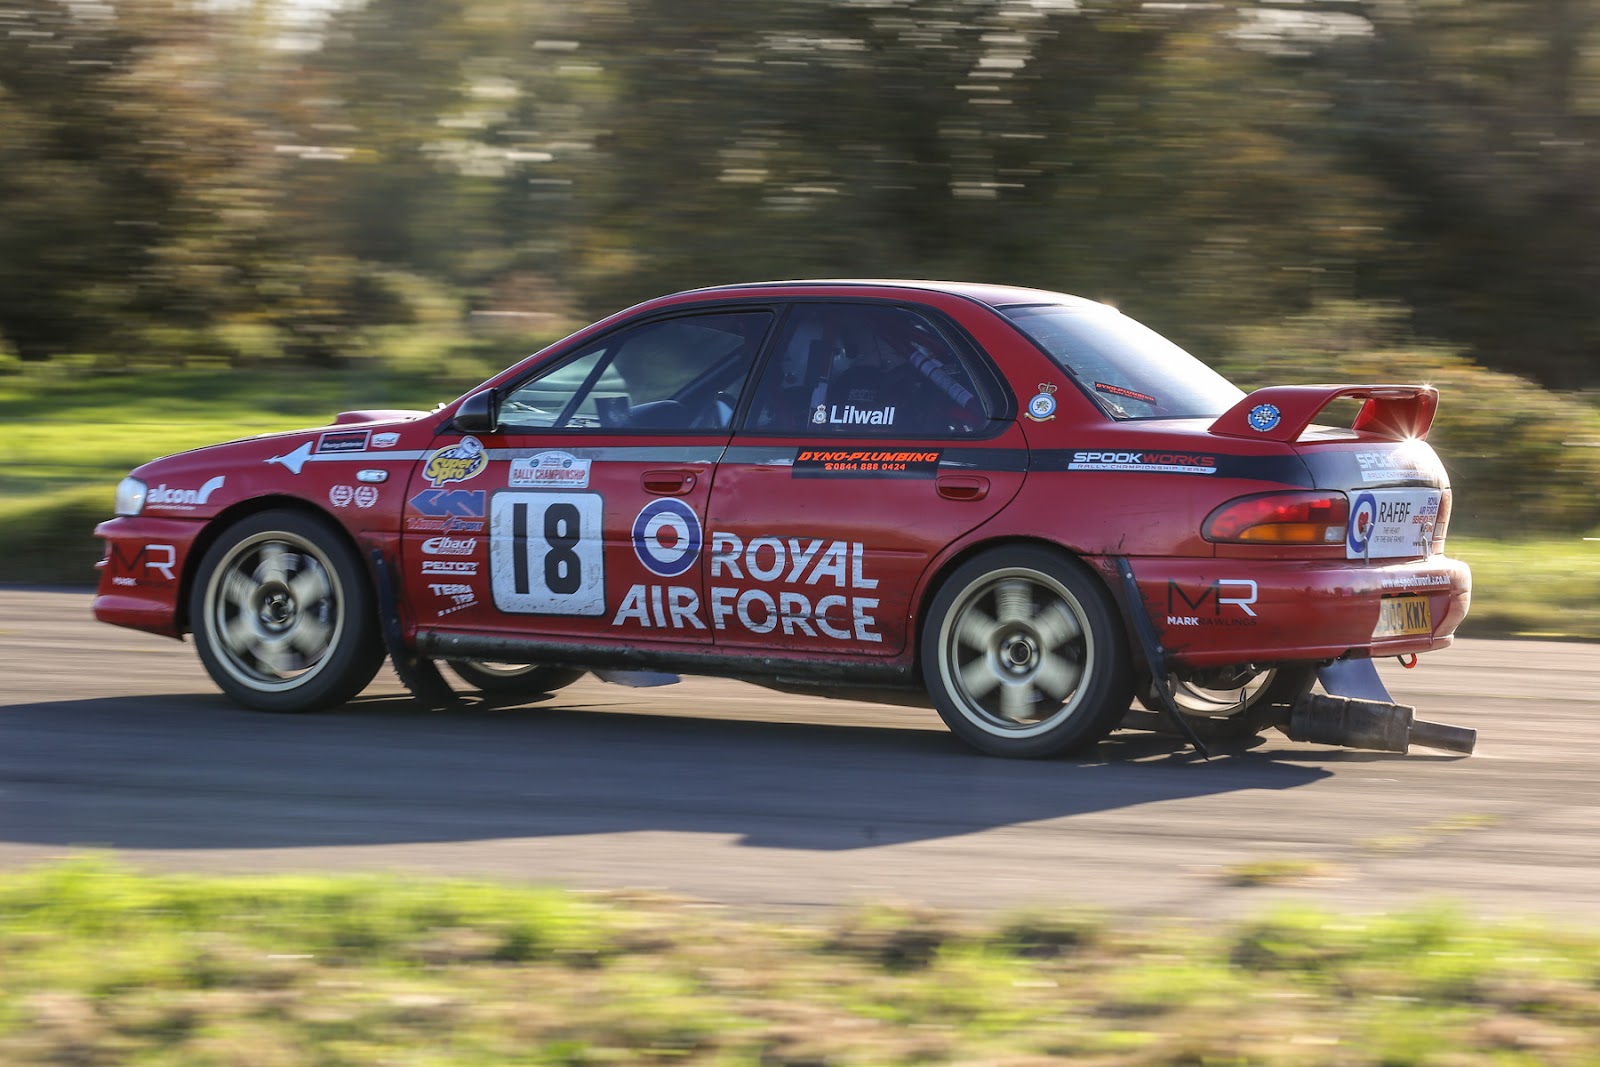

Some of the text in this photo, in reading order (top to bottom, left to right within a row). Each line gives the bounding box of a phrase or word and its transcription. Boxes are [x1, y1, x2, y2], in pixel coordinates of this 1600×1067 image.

[830, 405, 895, 425] Lilwall
[798, 452, 940, 463] DYNO-PLUMBING
[834, 463, 906, 471] 0844 888 0424
[1073, 452, 1215, 466] SPOOKWORKS
[513, 469, 586, 480] RALLY CHAMPIONSHIP
[146, 483, 199, 505] alcon
[1378, 502, 1412, 523] RAFBF
[513, 502, 582, 595] 18
[422, 561, 476, 571] PELTOR
[710, 531, 880, 590] ROYAL
[1168, 577, 1258, 617] MR
[611, 584, 883, 643] AIR FORCE
[1405, 601, 1428, 630] KWX
